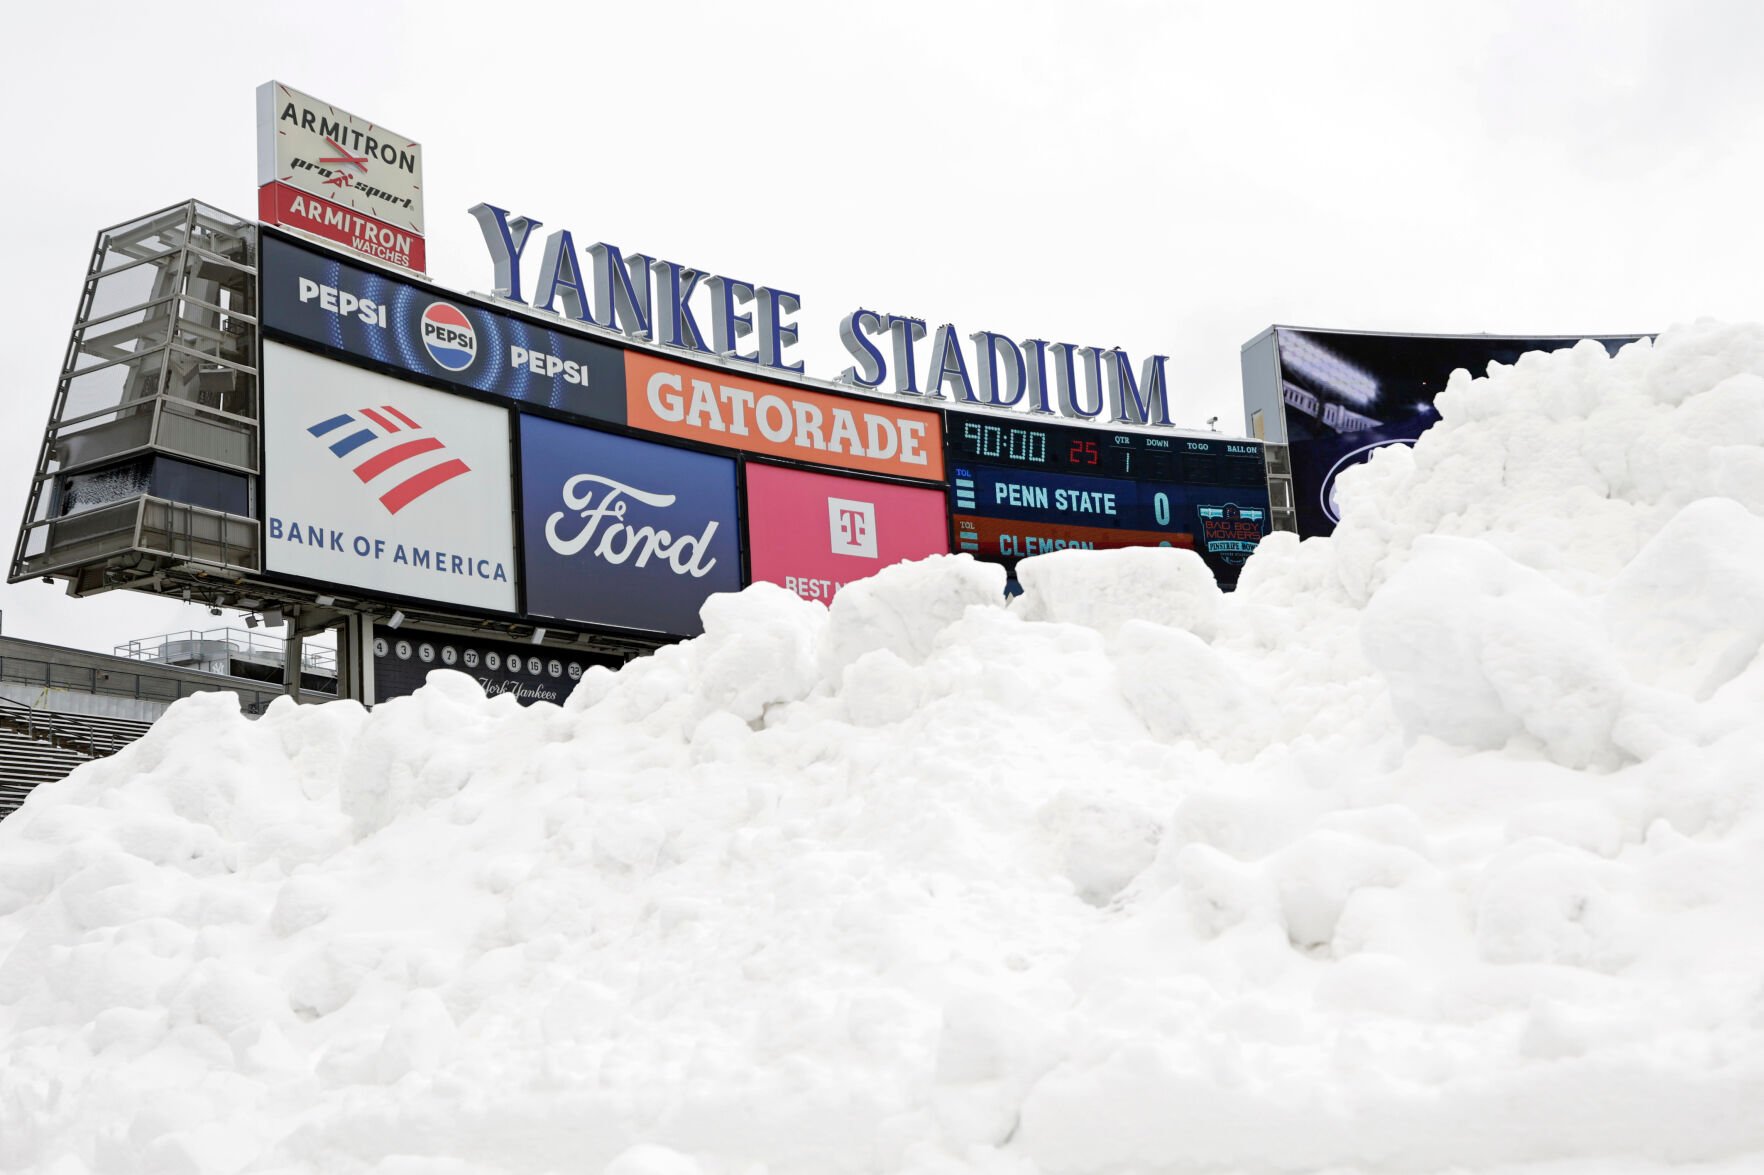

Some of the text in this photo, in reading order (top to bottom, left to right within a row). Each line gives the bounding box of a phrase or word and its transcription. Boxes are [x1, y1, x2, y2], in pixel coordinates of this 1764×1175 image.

[280, 102, 415, 174] ARMITRON
[290, 157, 412, 209] pro sport
[289, 195, 411, 255] ARMITRON
[352, 235, 409, 267] WATCHES
[299, 277, 387, 329] PEPSI
[467, 202, 1176, 427] YANKEE STADIUM
[424, 321, 473, 350] PEPSI
[510, 346, 589, 387] PEPSI
[646, 371, 928, 466] GATORADE
[964, 422, 1098, 465] 90:00 25
[1114, 435, 1130, 445] QTR
[1146, 438, 1169, 448] DOWN
[1227, 445, 1258, 454] BALL ON
[956, 468, 972, 478] TOL
[995, 482, 1118, 516] PENN STATE
[1153, 491, 1171, 526] 0
[545, 473, 720, 578] Ford
[960, 521, 976, 530] TOL
[1205, 520, 1259, 531] BAD BOY
[1206, 529, 1261, 540] MOWERS
[269, 517, 508, 583] BANK OF AMERICA
[785, 575, 831, 598] BEST
[376, 642, 580, 676] 4 3 5 7 37 8 8 16 15 32
[478, 677, 557, 699] York Yankees
